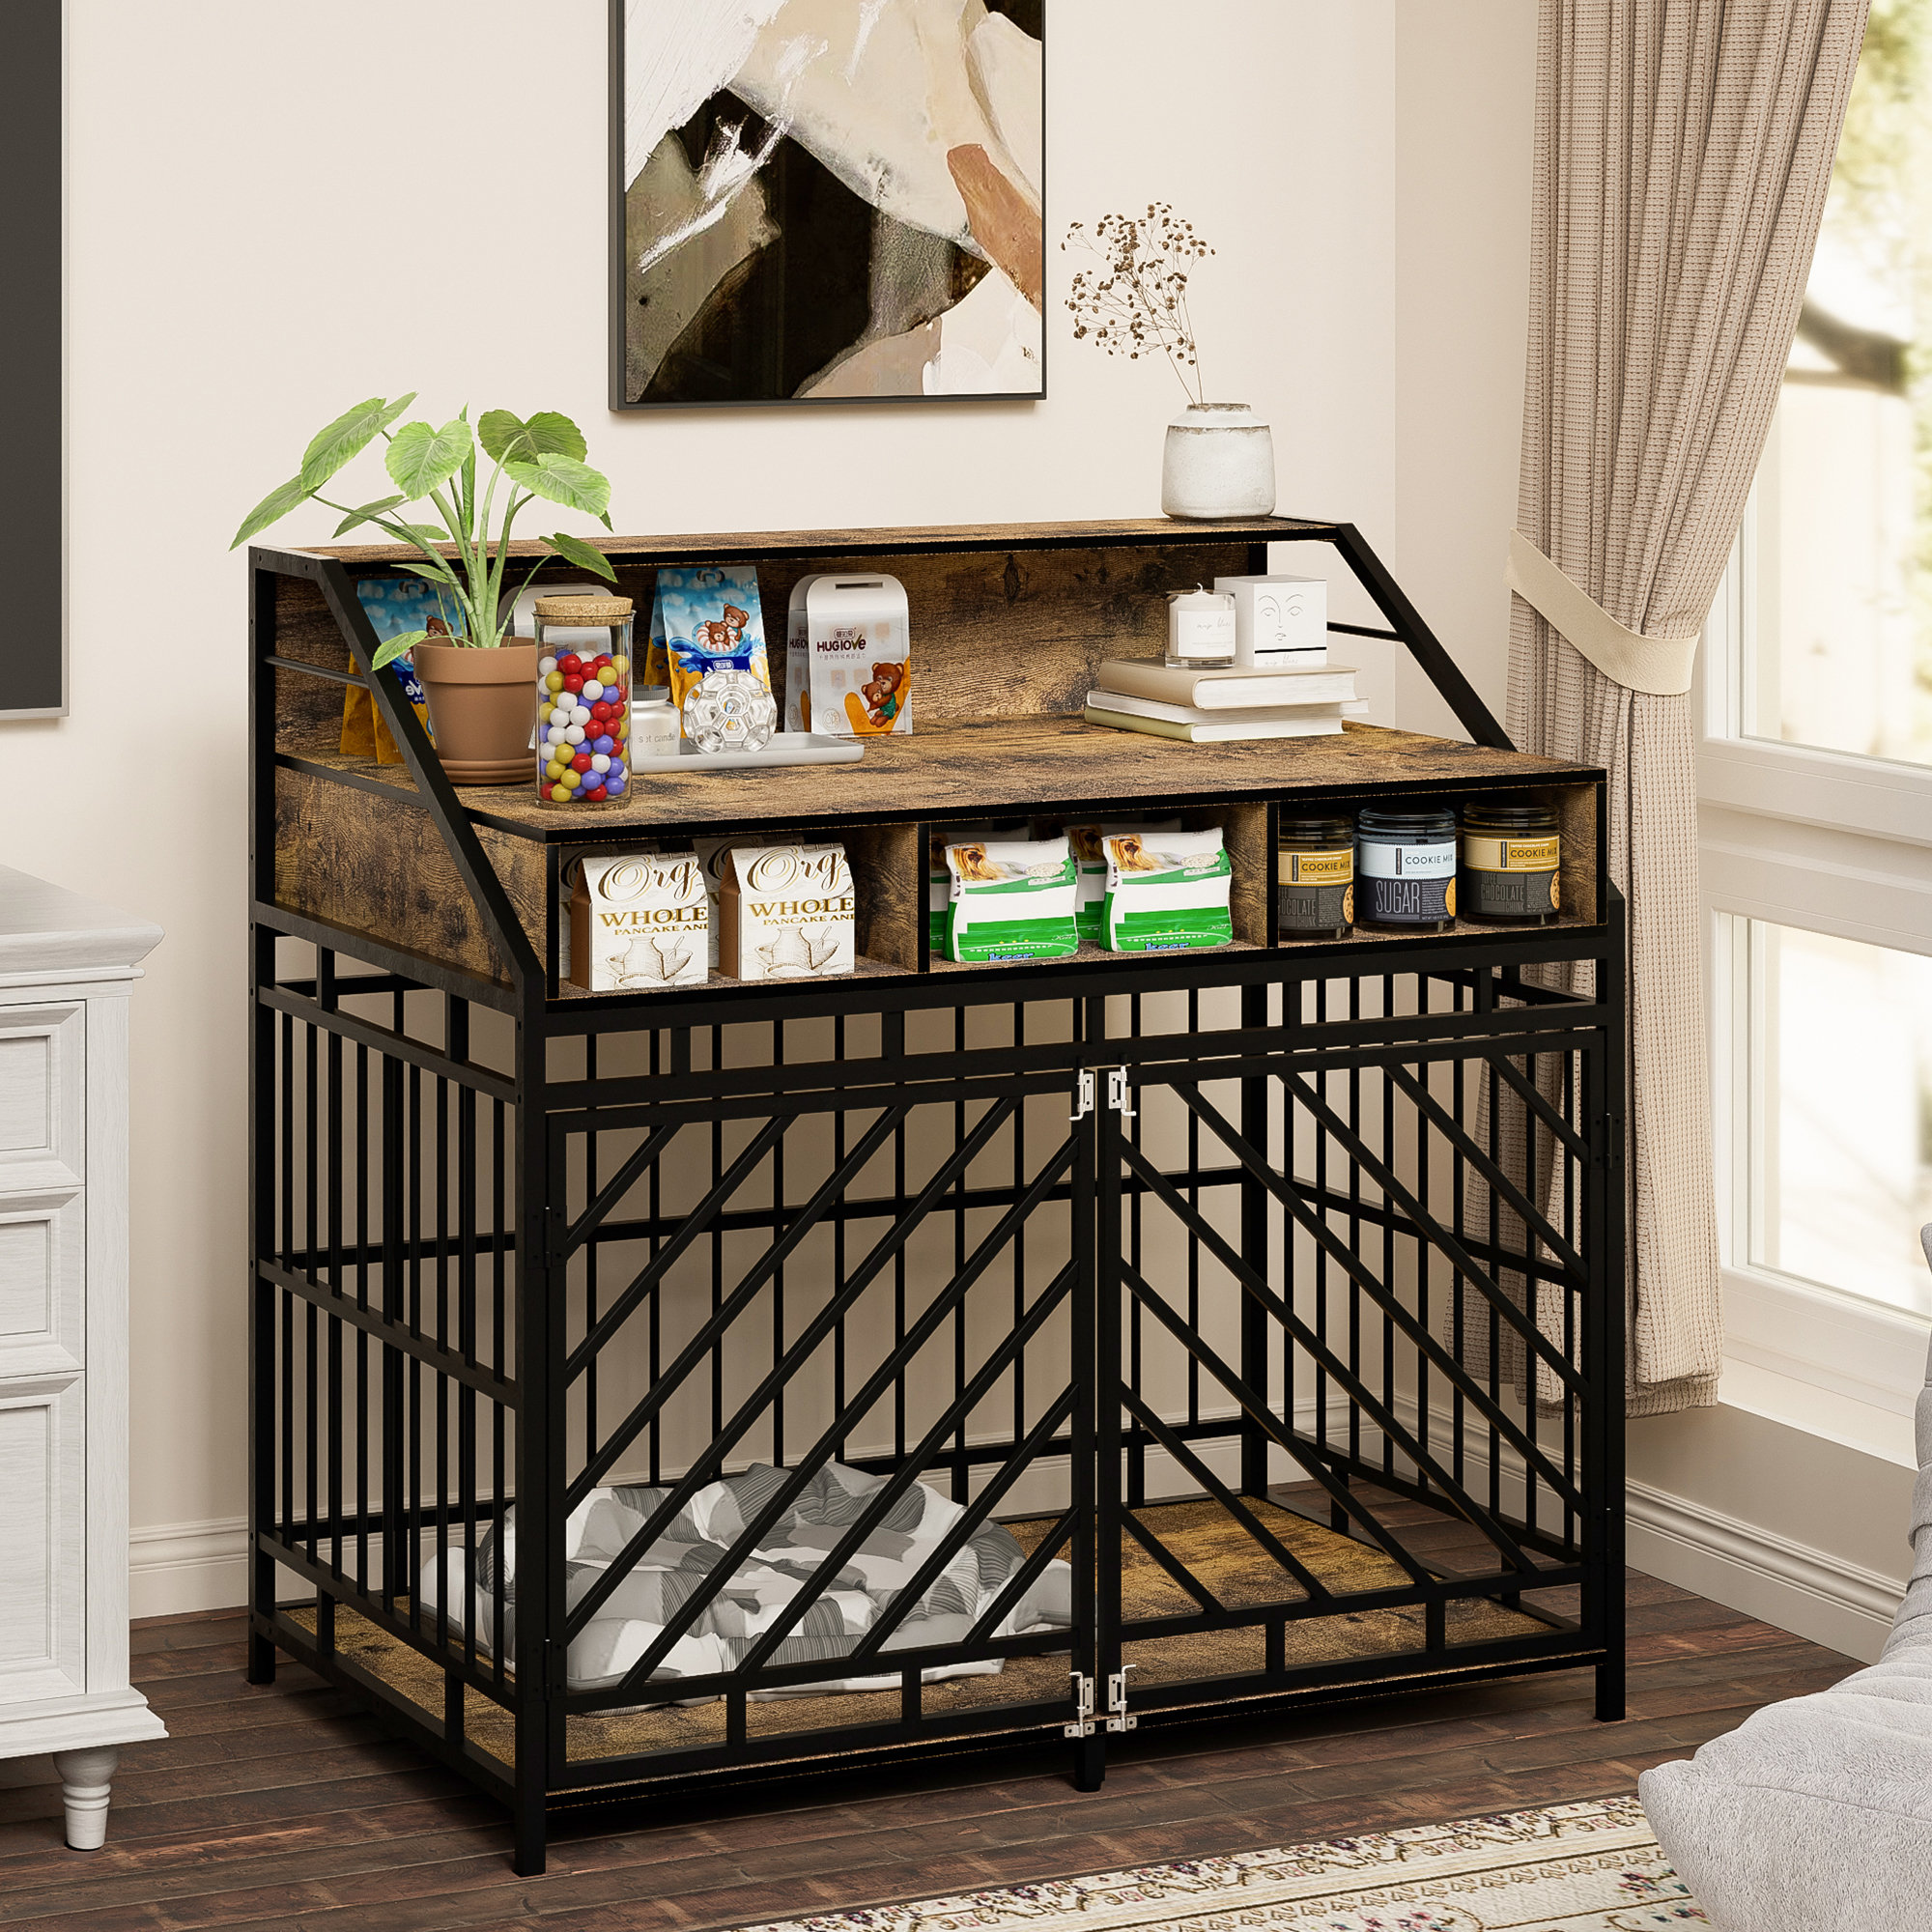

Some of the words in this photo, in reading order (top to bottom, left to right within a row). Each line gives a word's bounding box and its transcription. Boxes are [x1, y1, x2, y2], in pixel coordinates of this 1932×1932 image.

[1406, 855, 1441, 865] COOKIE
[1443, 854, 1453, 863] MIX
[1510, 848, 1546, 858] COOKIE
[1548, 847, 1557, 856] MIX
[747, 847, 849, 893] Org
[1301, 862, 1338, 871] COOKIE
[1340, 861, 1350, 869] MIX
[598, 856, 702, 902] Org
[1376, 880, 1420, 914] SUGAR
[1481, 883, 1524, 901] CHOCOLATE
[748, 897, 854, 917] WHOLE
[598, 907, 708, 927] WHOLE
[763, 916, 826, 925] PANCAKE
[614, 925, 680, 935] PANCAKE
